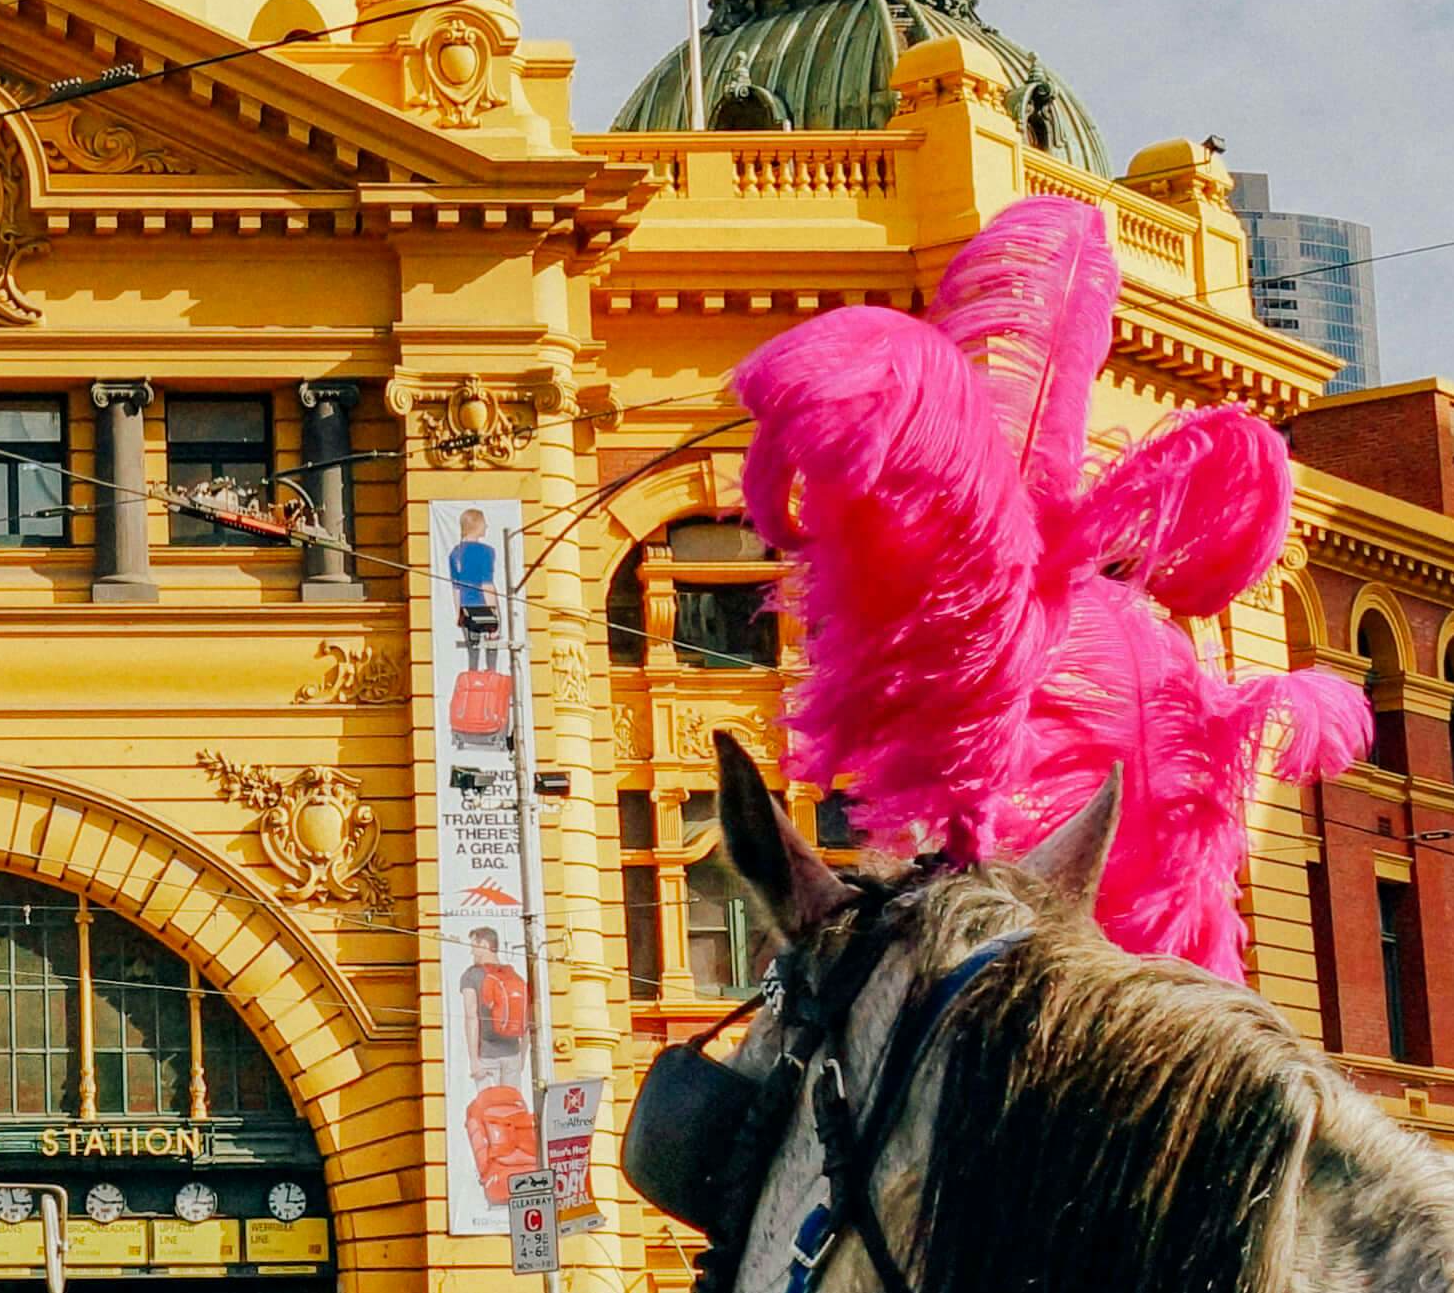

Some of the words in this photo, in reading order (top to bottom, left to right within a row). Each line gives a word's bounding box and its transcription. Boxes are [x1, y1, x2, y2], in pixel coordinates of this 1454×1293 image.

[456, 843, 466, 855] A
[472, 858, 508, 869] BAG.
[42, 1128, 202, 1157] STATION
[527, 1210, 540, 1231] C
